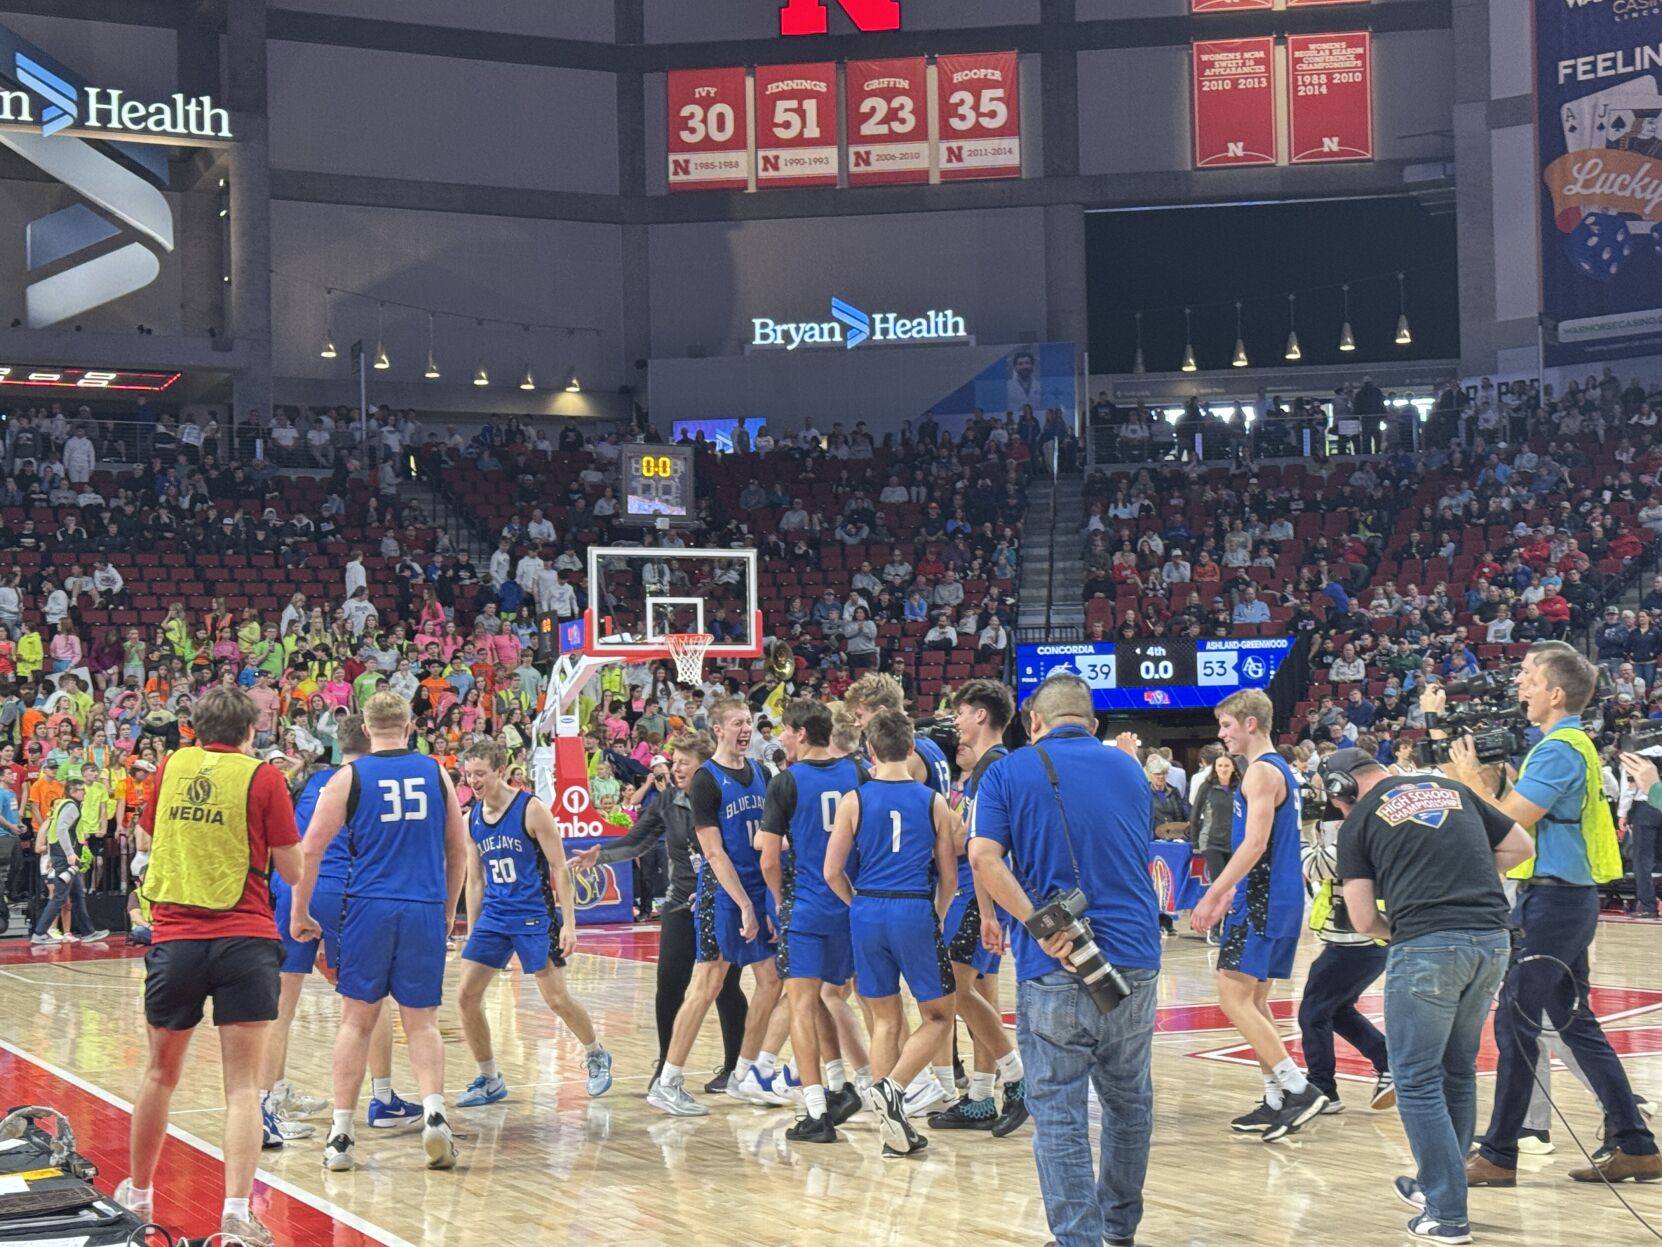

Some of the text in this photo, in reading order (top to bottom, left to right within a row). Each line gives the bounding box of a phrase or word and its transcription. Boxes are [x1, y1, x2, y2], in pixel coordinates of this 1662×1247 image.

[864, 78, 910, 91] GRIFFIN
[952, 69, 1002, 83] HOOPER
[1202, 77, 1268, 91] 2010 2013
[1297, 72, 1362, 85] 1988 2010
[694, 87, 717, 98] IVY
[765, 80, 828, 95] JENNINGS
[1297, 85, 1328, 96] 2014
[84, 86, 233, 138] Health
[859, 96, 916, 135] 23
[949, 88, 1008, 130] 35
[680, 103, 734, 143] 30
[772, 99, 820, 139] 51
[967, 147, 1013, 157] 2011-2014
[1563, 158, 1662, 214] Lucky
[752, 309, 967, 350] Bryan Health
[1037, 645, 1095, 655] CONCORDIA
[1146, 646, 1166, 656] 4th
[1206, 639, 1288, 650] ASHLAND-GREENWOOD
[1087, 664, 1111, 680] 39
[1140, 660, 1173, 679] 0.0
[1203, 660, 1227, 677] 53
[378, 777, 428, 822] 35
[1381, 790, 1457, 817] HIGH SCHOOL
[889, 810, 902, 853] 1
[489, 857, 517, 883] 20
